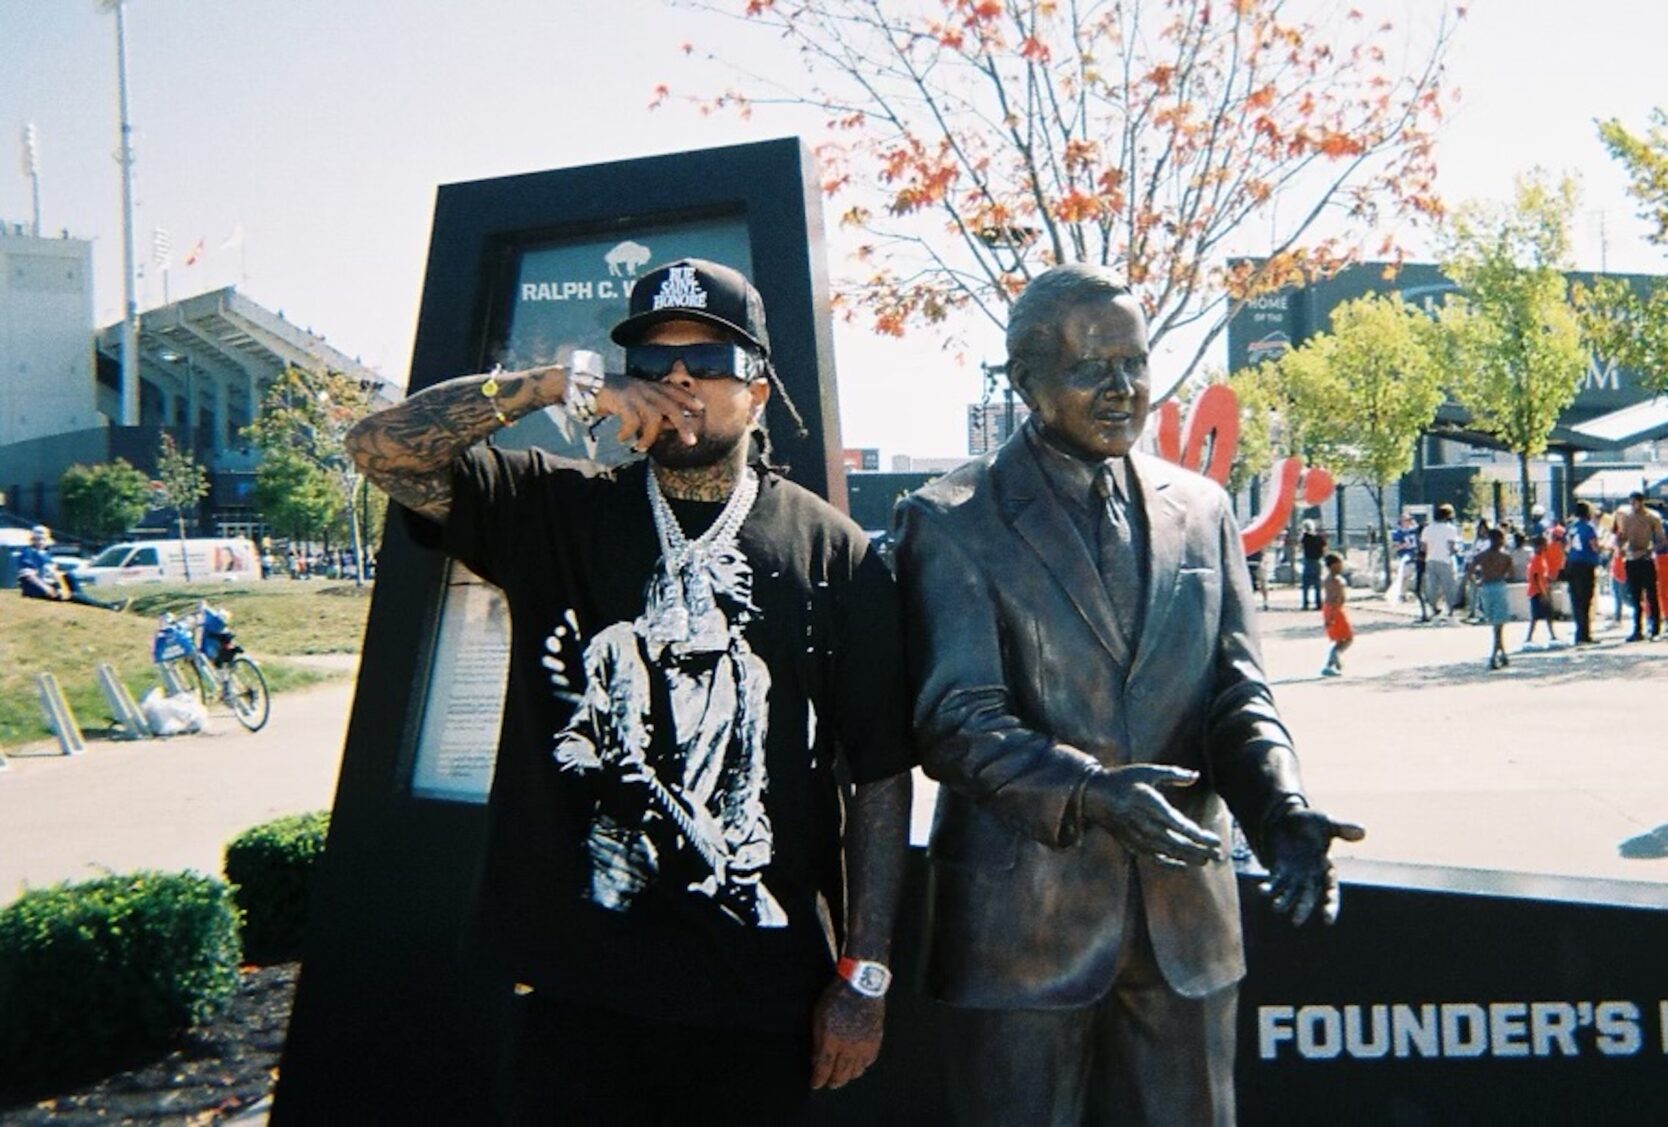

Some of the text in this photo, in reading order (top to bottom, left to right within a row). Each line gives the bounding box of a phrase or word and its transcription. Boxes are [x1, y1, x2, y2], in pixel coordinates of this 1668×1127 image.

[669, 267, 696, 282] RUE
[522, 282, 592, 300] RALPH
[598, 281, 618, 298] C.
[1248, 297, 1287, 309] HOME
[1258, 1001, 1642, 1059] FOUNDER'S
